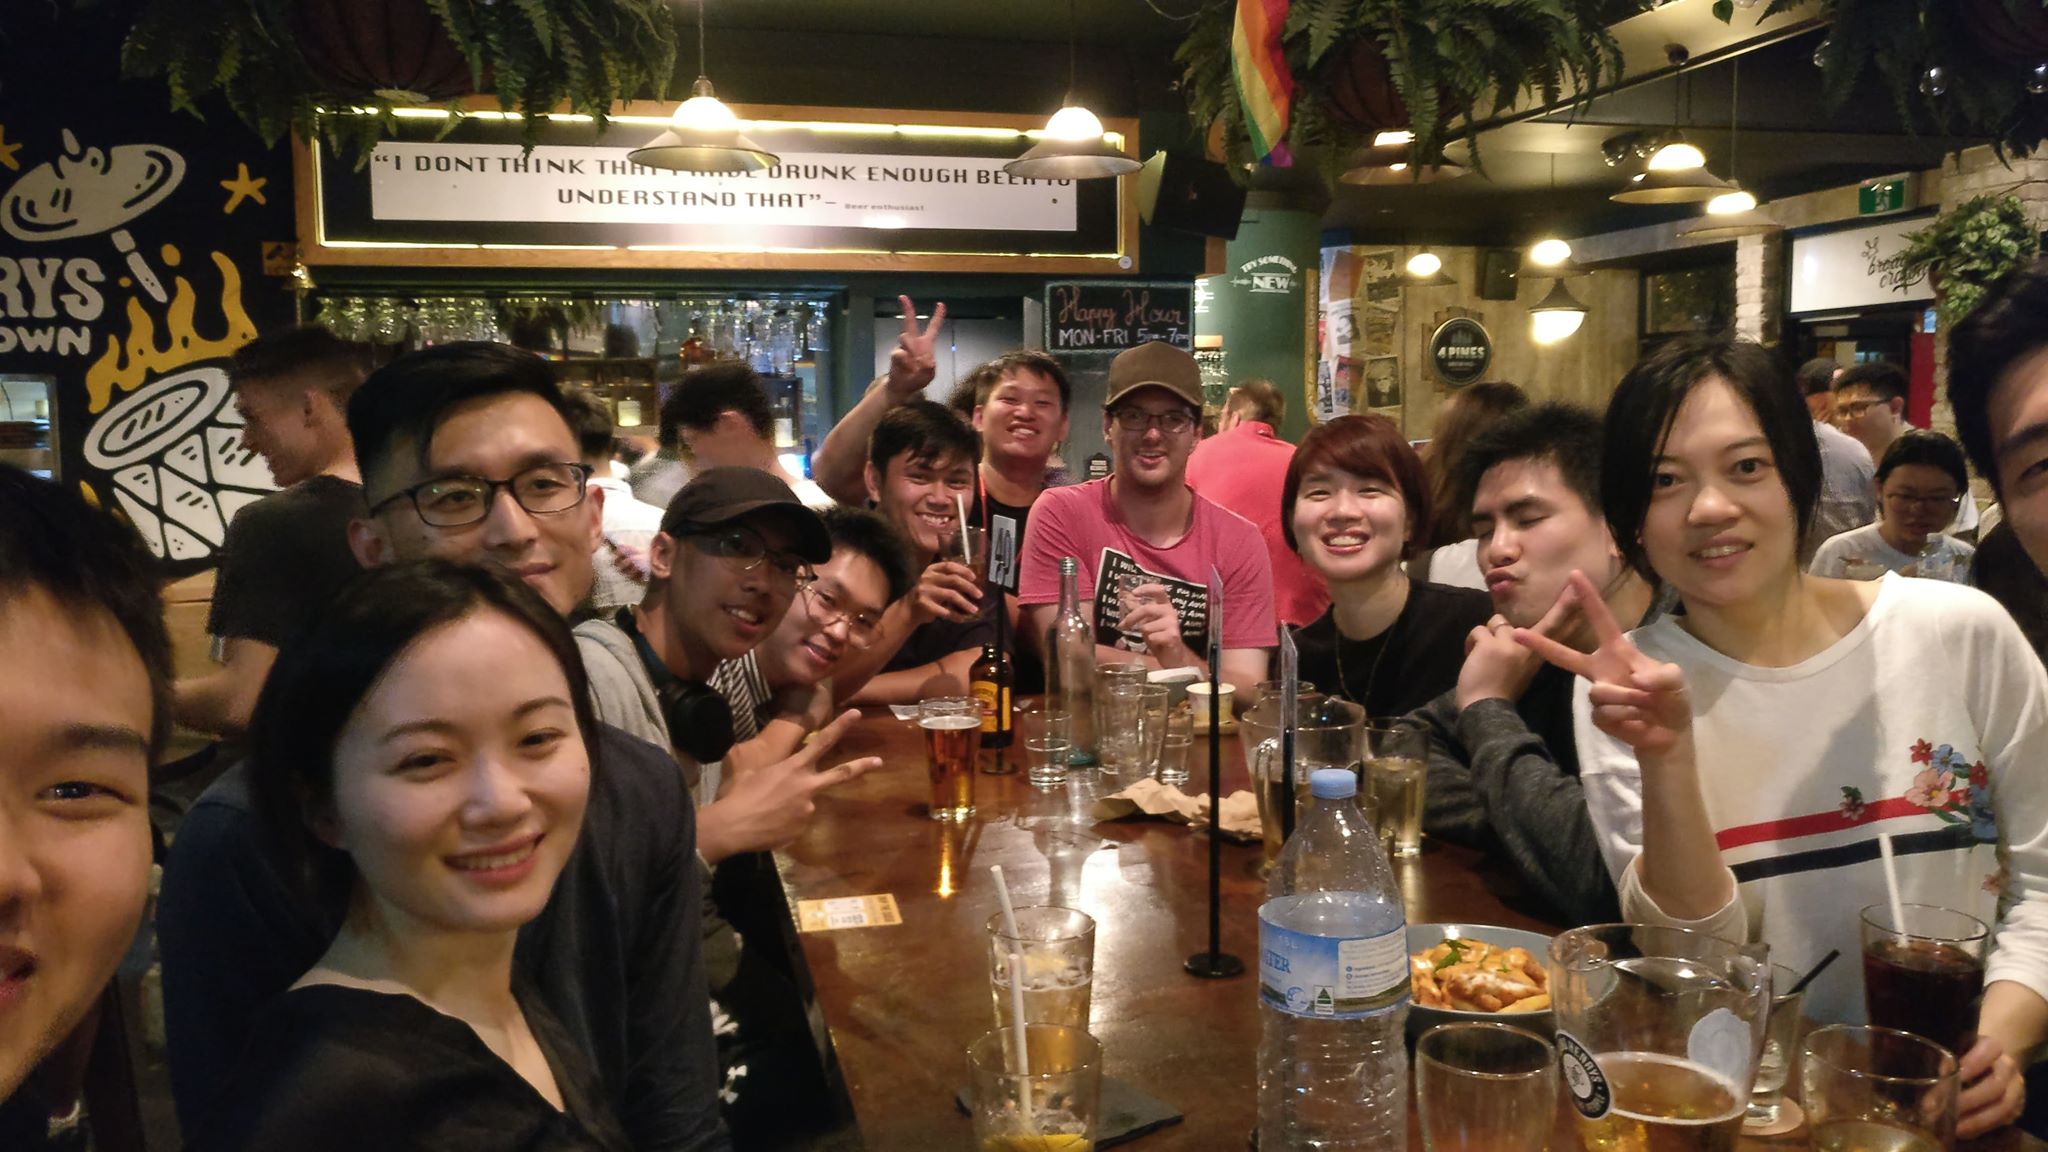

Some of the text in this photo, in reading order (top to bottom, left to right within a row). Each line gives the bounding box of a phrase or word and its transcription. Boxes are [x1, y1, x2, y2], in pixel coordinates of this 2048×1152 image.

[415, 155, 489, 173] DONT
[500, 156, 584, 174] THINK
[769, 164, 856, 181] DRUNK
[868, 166, 967, 184] ENOUGH
[558, 188, 735, 207] UNDERSTAND
[1252, 276, 1290, 289] NEW
[1057, 283, 1186, 329] Happy Hour
[1058, 328, 1129, 347] MON-FRI
[1437, 346, 1486, 359] 4 PINES
